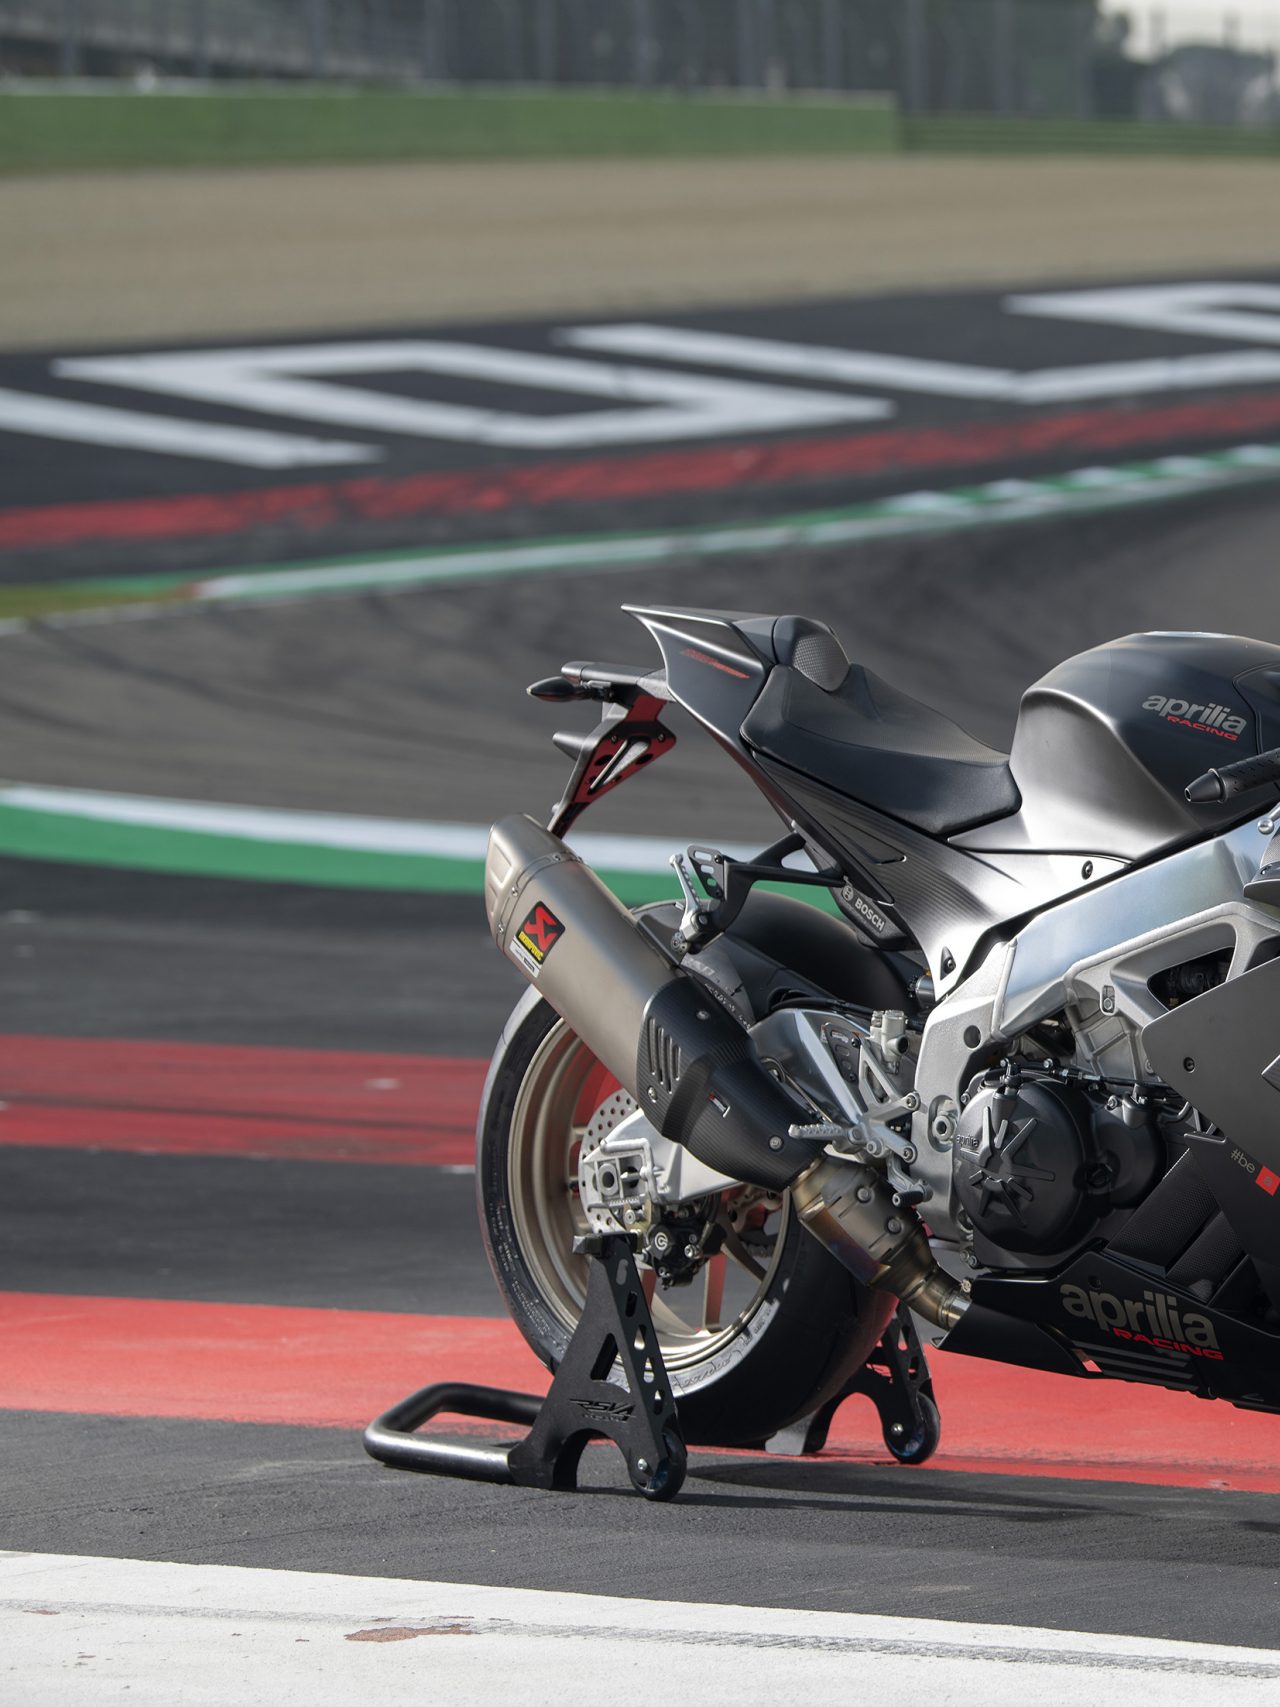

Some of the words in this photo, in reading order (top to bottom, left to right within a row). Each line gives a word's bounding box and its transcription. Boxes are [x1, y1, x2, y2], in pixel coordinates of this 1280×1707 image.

[1141, 694, 1248, 735] aprilia
[1166, 714, 1240, 742] RACING
[854, 897, 885, 932] BOSCH
[1230, 1148, 1256, 1174] #be
[1059, 1283, 1220, 1350] aprilia
[1112, 1327, 1225, 1361] RACING
